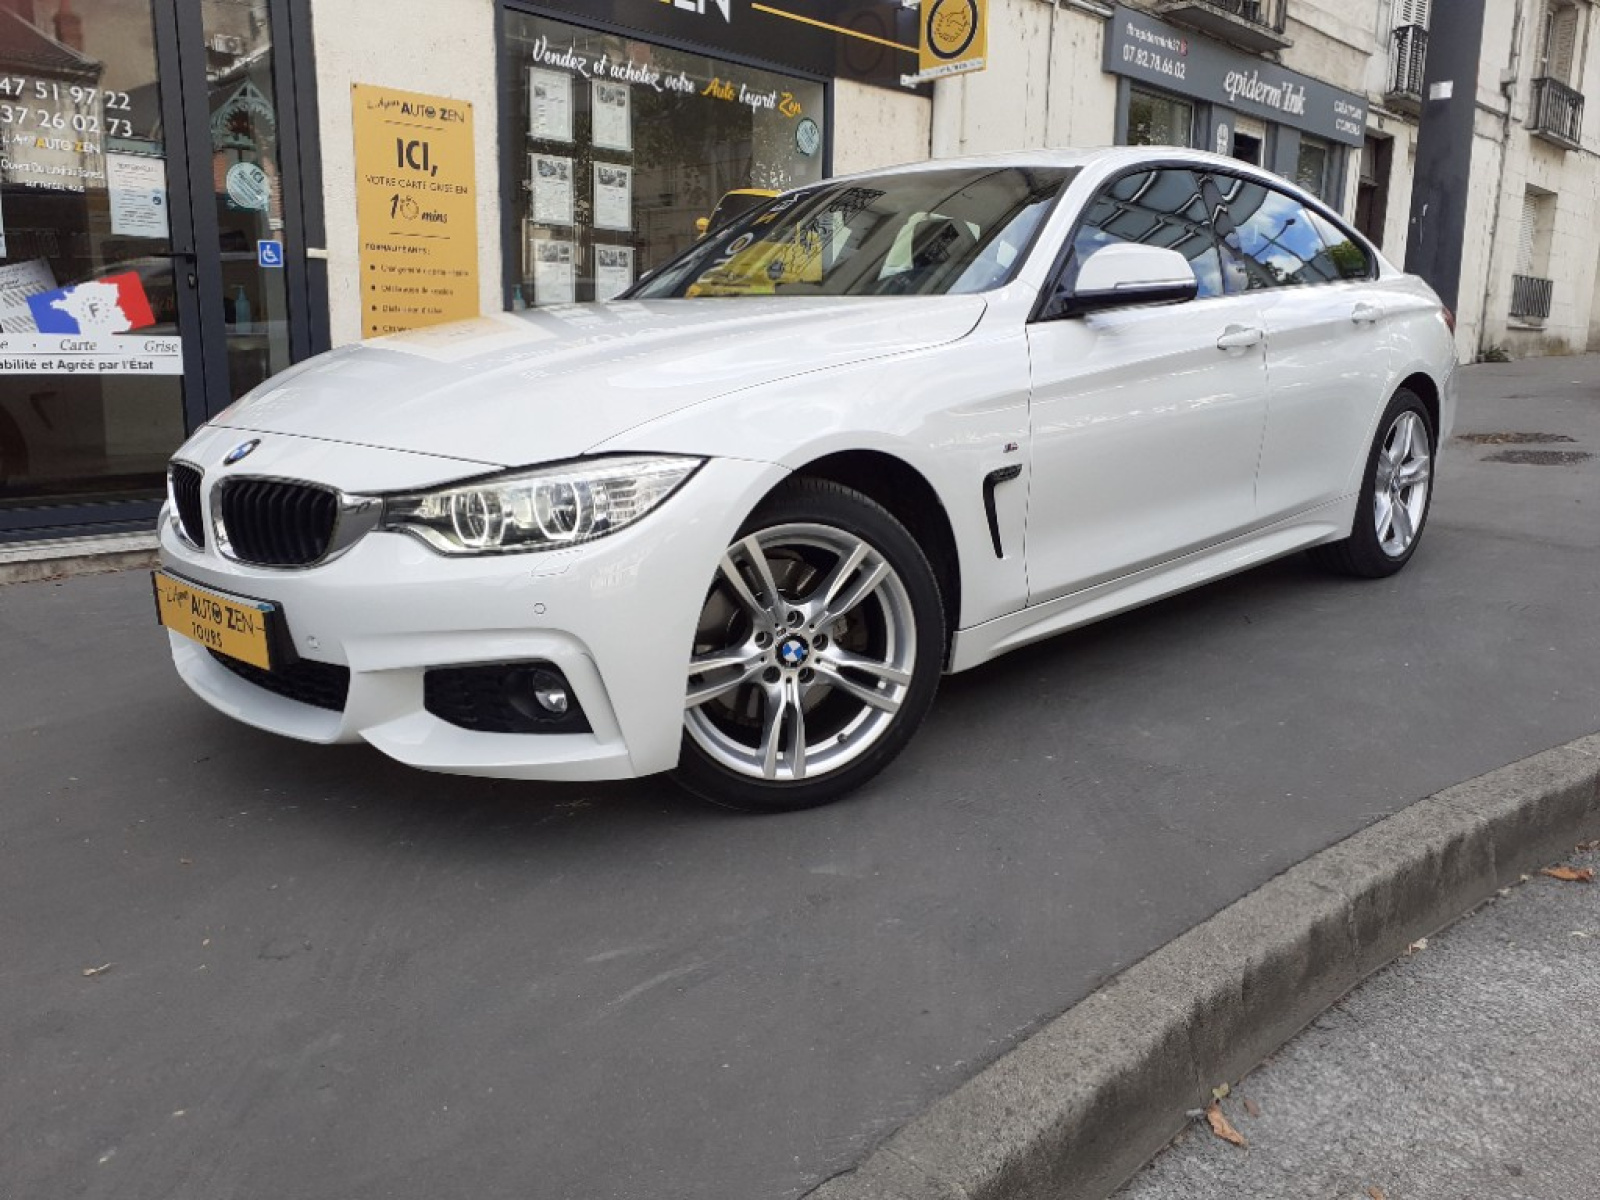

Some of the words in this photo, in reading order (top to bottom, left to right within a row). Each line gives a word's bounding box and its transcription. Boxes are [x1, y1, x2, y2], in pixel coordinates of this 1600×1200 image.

[532, 34, 592, 79] Vendez
[592, 53, 608, 76] et
[610, 58, 664, 93] achetez
[664, 71, 697, 94] votre
[700, 77, 736, 101] Auto
[778, 90, 803, 119] Zen
[0, 77, 26, 96] 47
[35, 80, 59, 101] 51
[69, 85, 98, 105] 97
[104, 90, 132, 111] 22
[0, 104, 29, 125] 37
[37, 108, 66, 130] 26
[72, 113, 101, 134] 02
[105, 117, 133, 137] 73
[401, 102, 437, 119] AUTO
[439, 107, 465, 123] ZEN
[396, 137, 438, 177] ICI,
[455, 185, 468, 195] EN
[60, 338, 98, 351] Carte
[41, 360, 54, 370] et
[57, 359, 95, 372] Agréé
[99, 361, 119, 373] par
[191, 593, 223, 625] AUTO
[226, 605, 254, 635] ZEN
